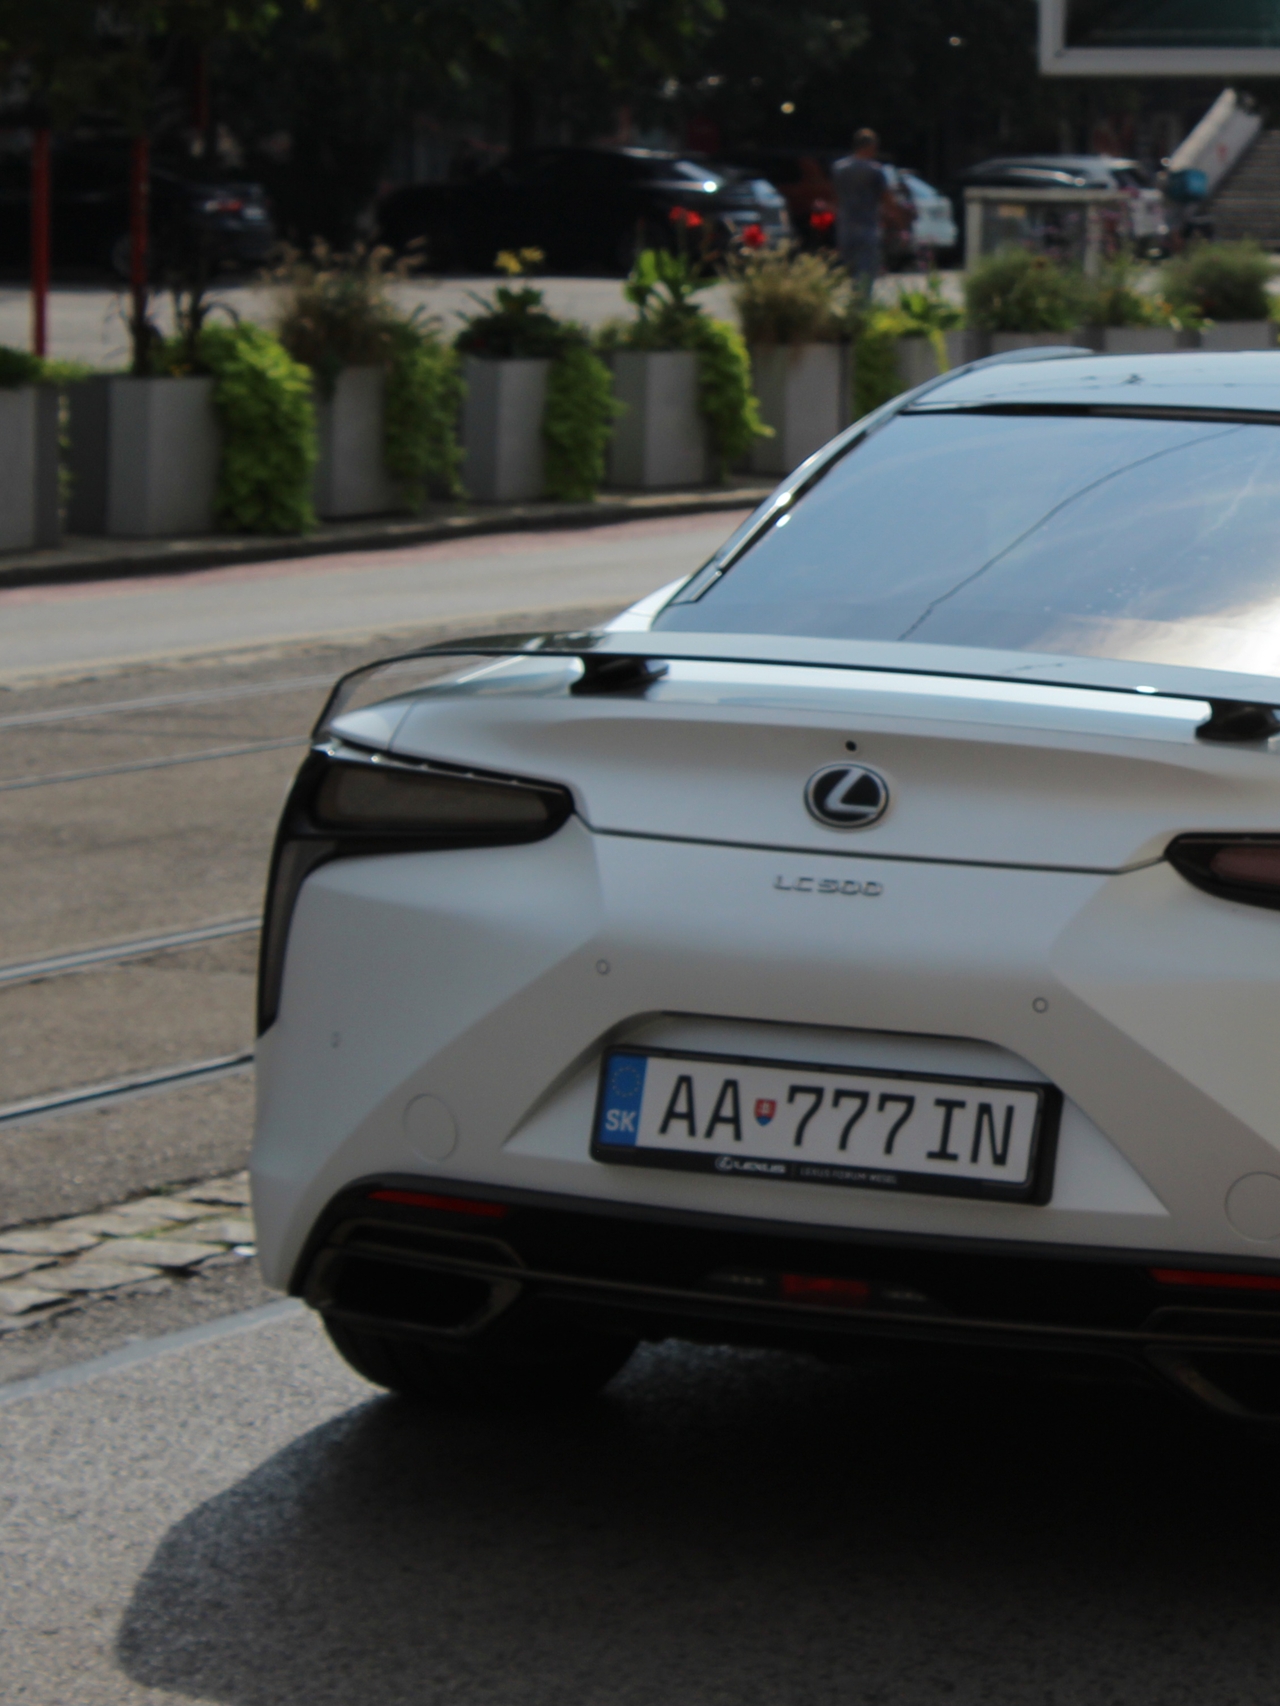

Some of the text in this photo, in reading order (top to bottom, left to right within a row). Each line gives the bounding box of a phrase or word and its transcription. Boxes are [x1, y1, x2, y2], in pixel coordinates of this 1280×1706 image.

[659, 1074, 742, 1141] AA
[605, 1108, 636, 1132] SK
[733, 1160, 786, 1174] LEXUS
